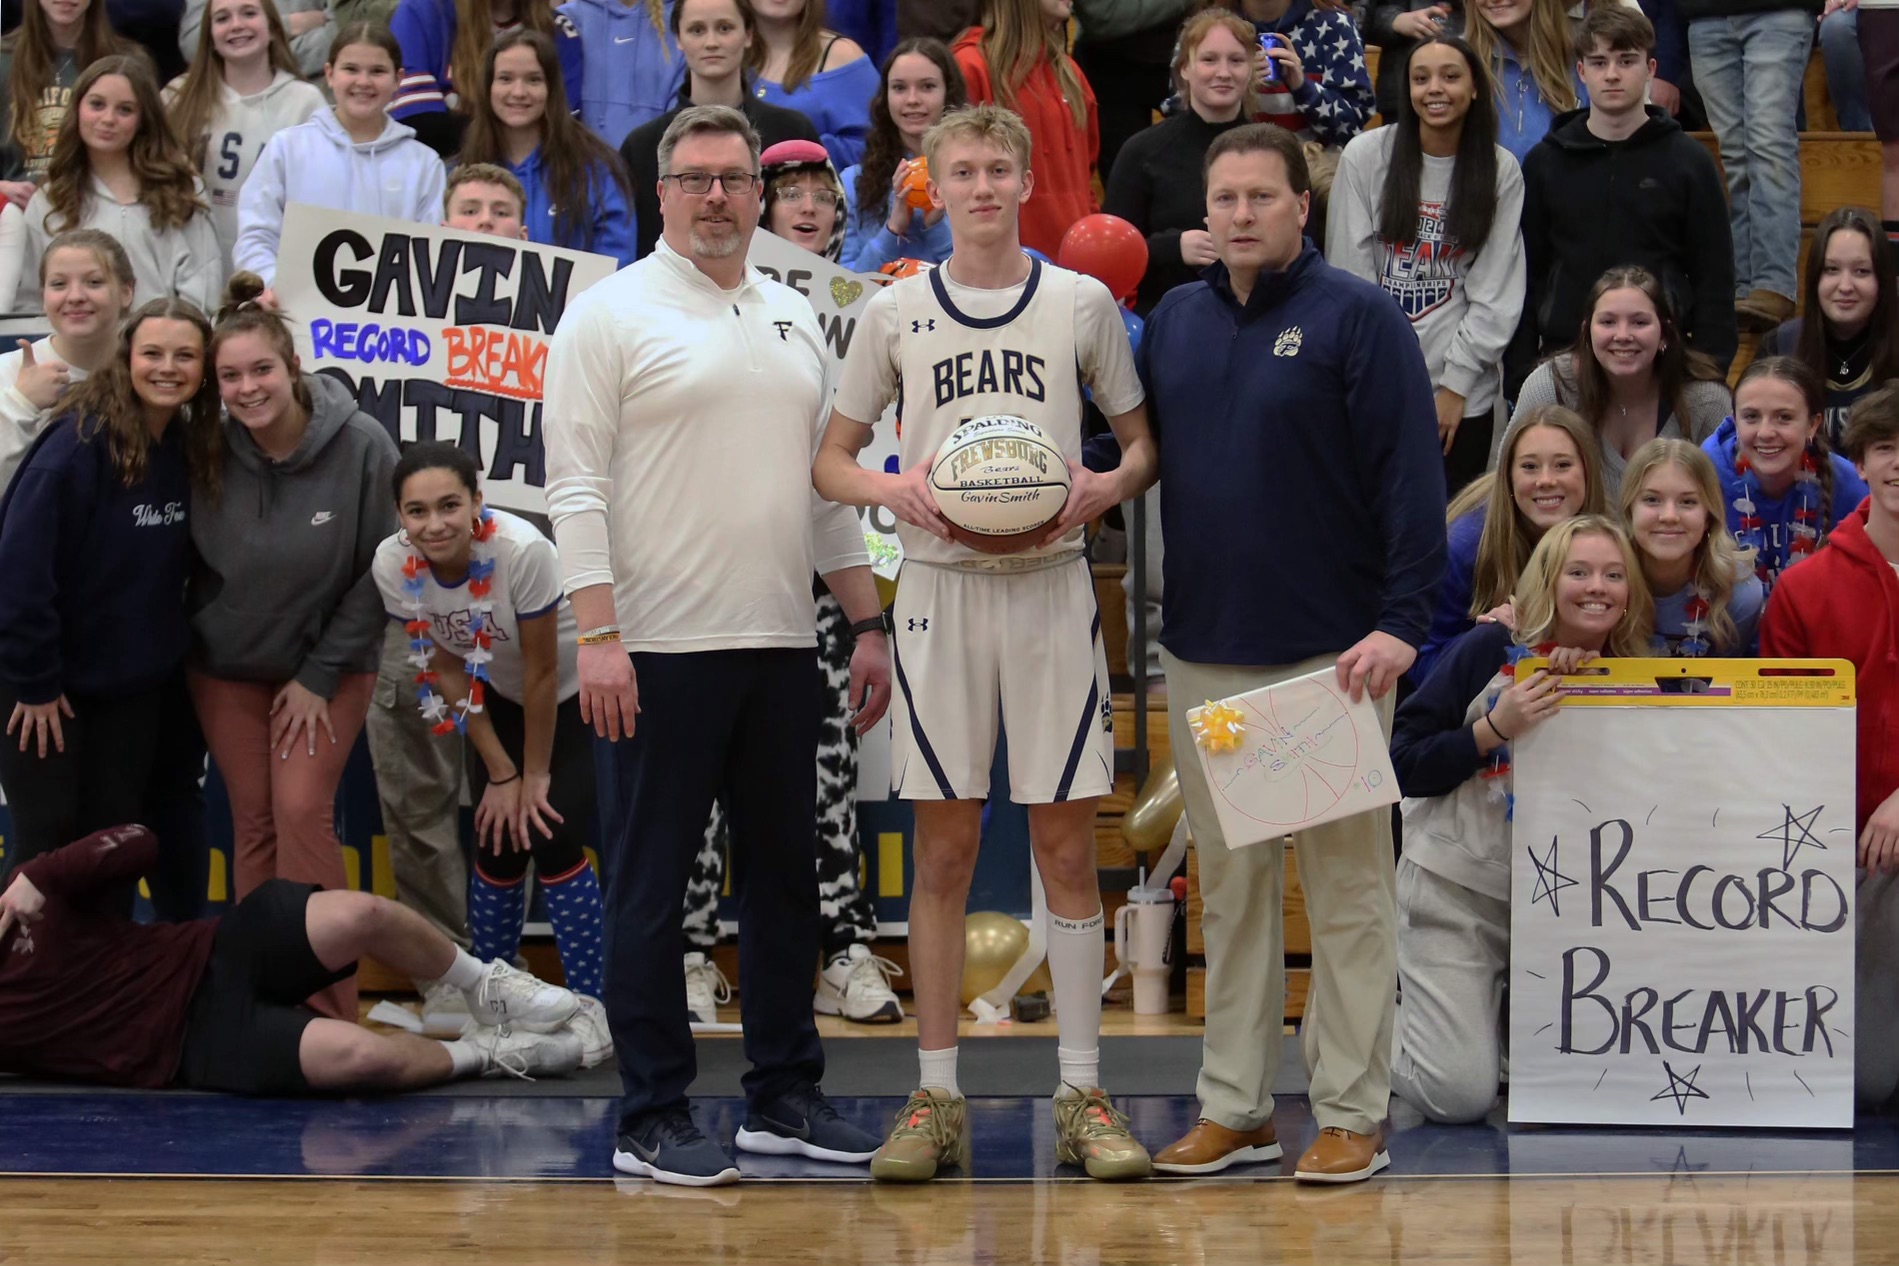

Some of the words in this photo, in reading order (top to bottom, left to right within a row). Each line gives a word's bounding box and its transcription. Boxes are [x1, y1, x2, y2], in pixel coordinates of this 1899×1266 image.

[313, 229, 574, 335] GAVIN
[310, 318, 430, 366] RECORD
[932, 349, 1045, 409] BEARS
[952, 419, 1043, 444] SPALDING
[950, 439, 1048, 482] FREWSBURG
[960, 475, 1044, 488] BASKETBALL
[980, 465, 1020, 474] Bears
[1243, 726, 1293, 769] GAVIN
[1590, 819, 1848, 932] RECORD
[1054, 919, 1077, 930] RUN
[1555, 946, 1839, 1058] BREAKER
